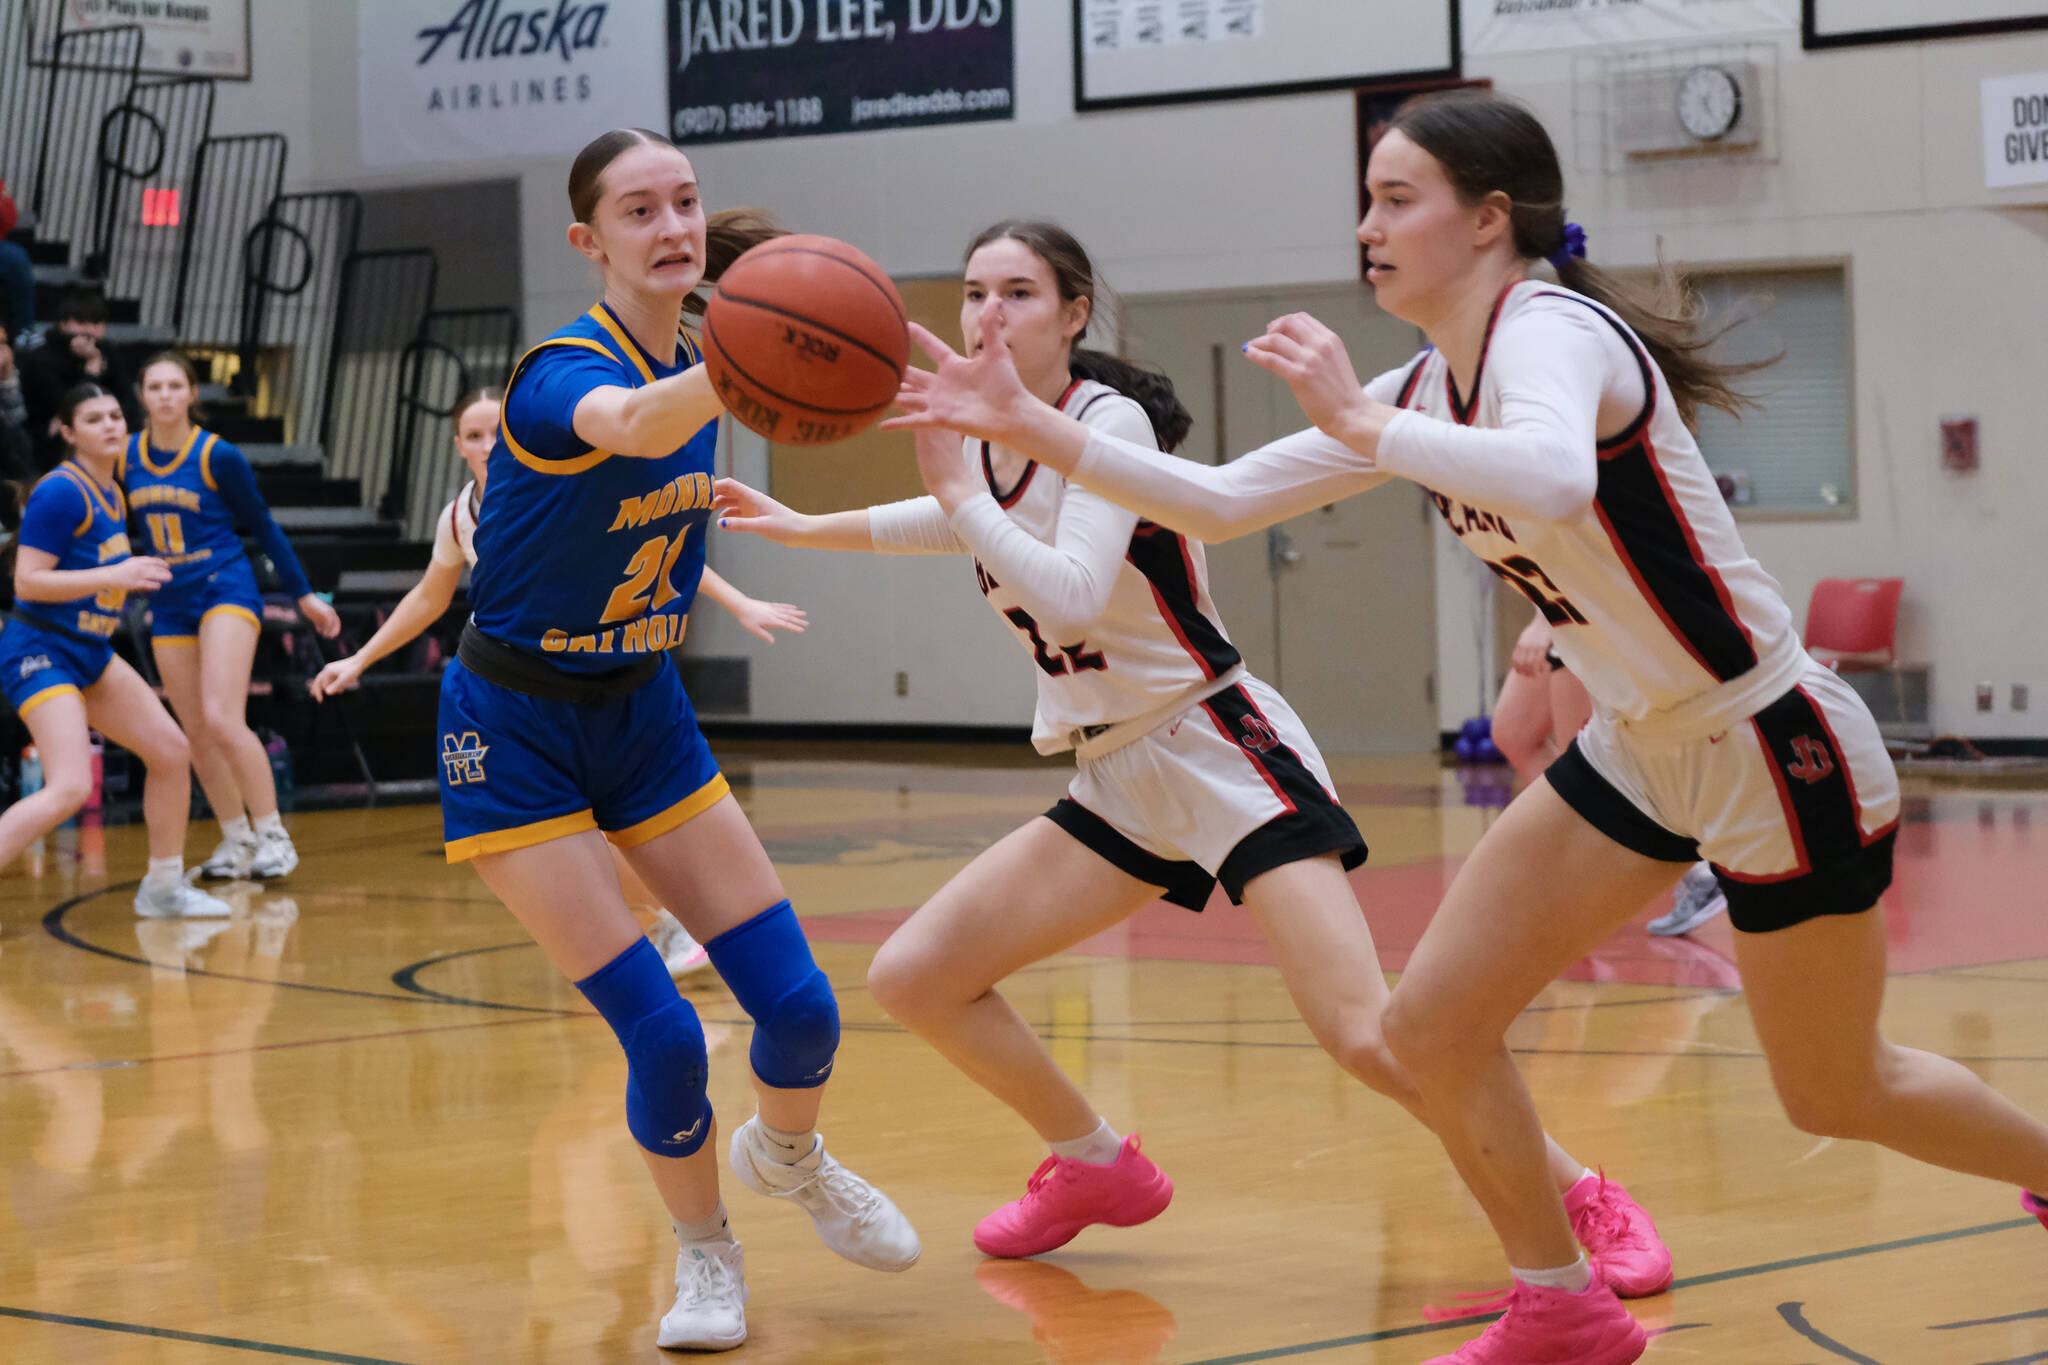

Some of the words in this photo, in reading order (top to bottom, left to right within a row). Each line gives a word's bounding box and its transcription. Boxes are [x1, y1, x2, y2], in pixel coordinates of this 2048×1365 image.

[416, 0, 607, 66] Alaska
[677, 0, 805, 73] JARED
[816, 0, 896, 44] LEE,
[908, 0, 1002, 33] DDS
[428, 73, 591, 111] AIRLINES
[2005, 130, 2048, 165] GIVE
[606, 471, 716, 533] MONR
[598, 522, 683, 625] 21
